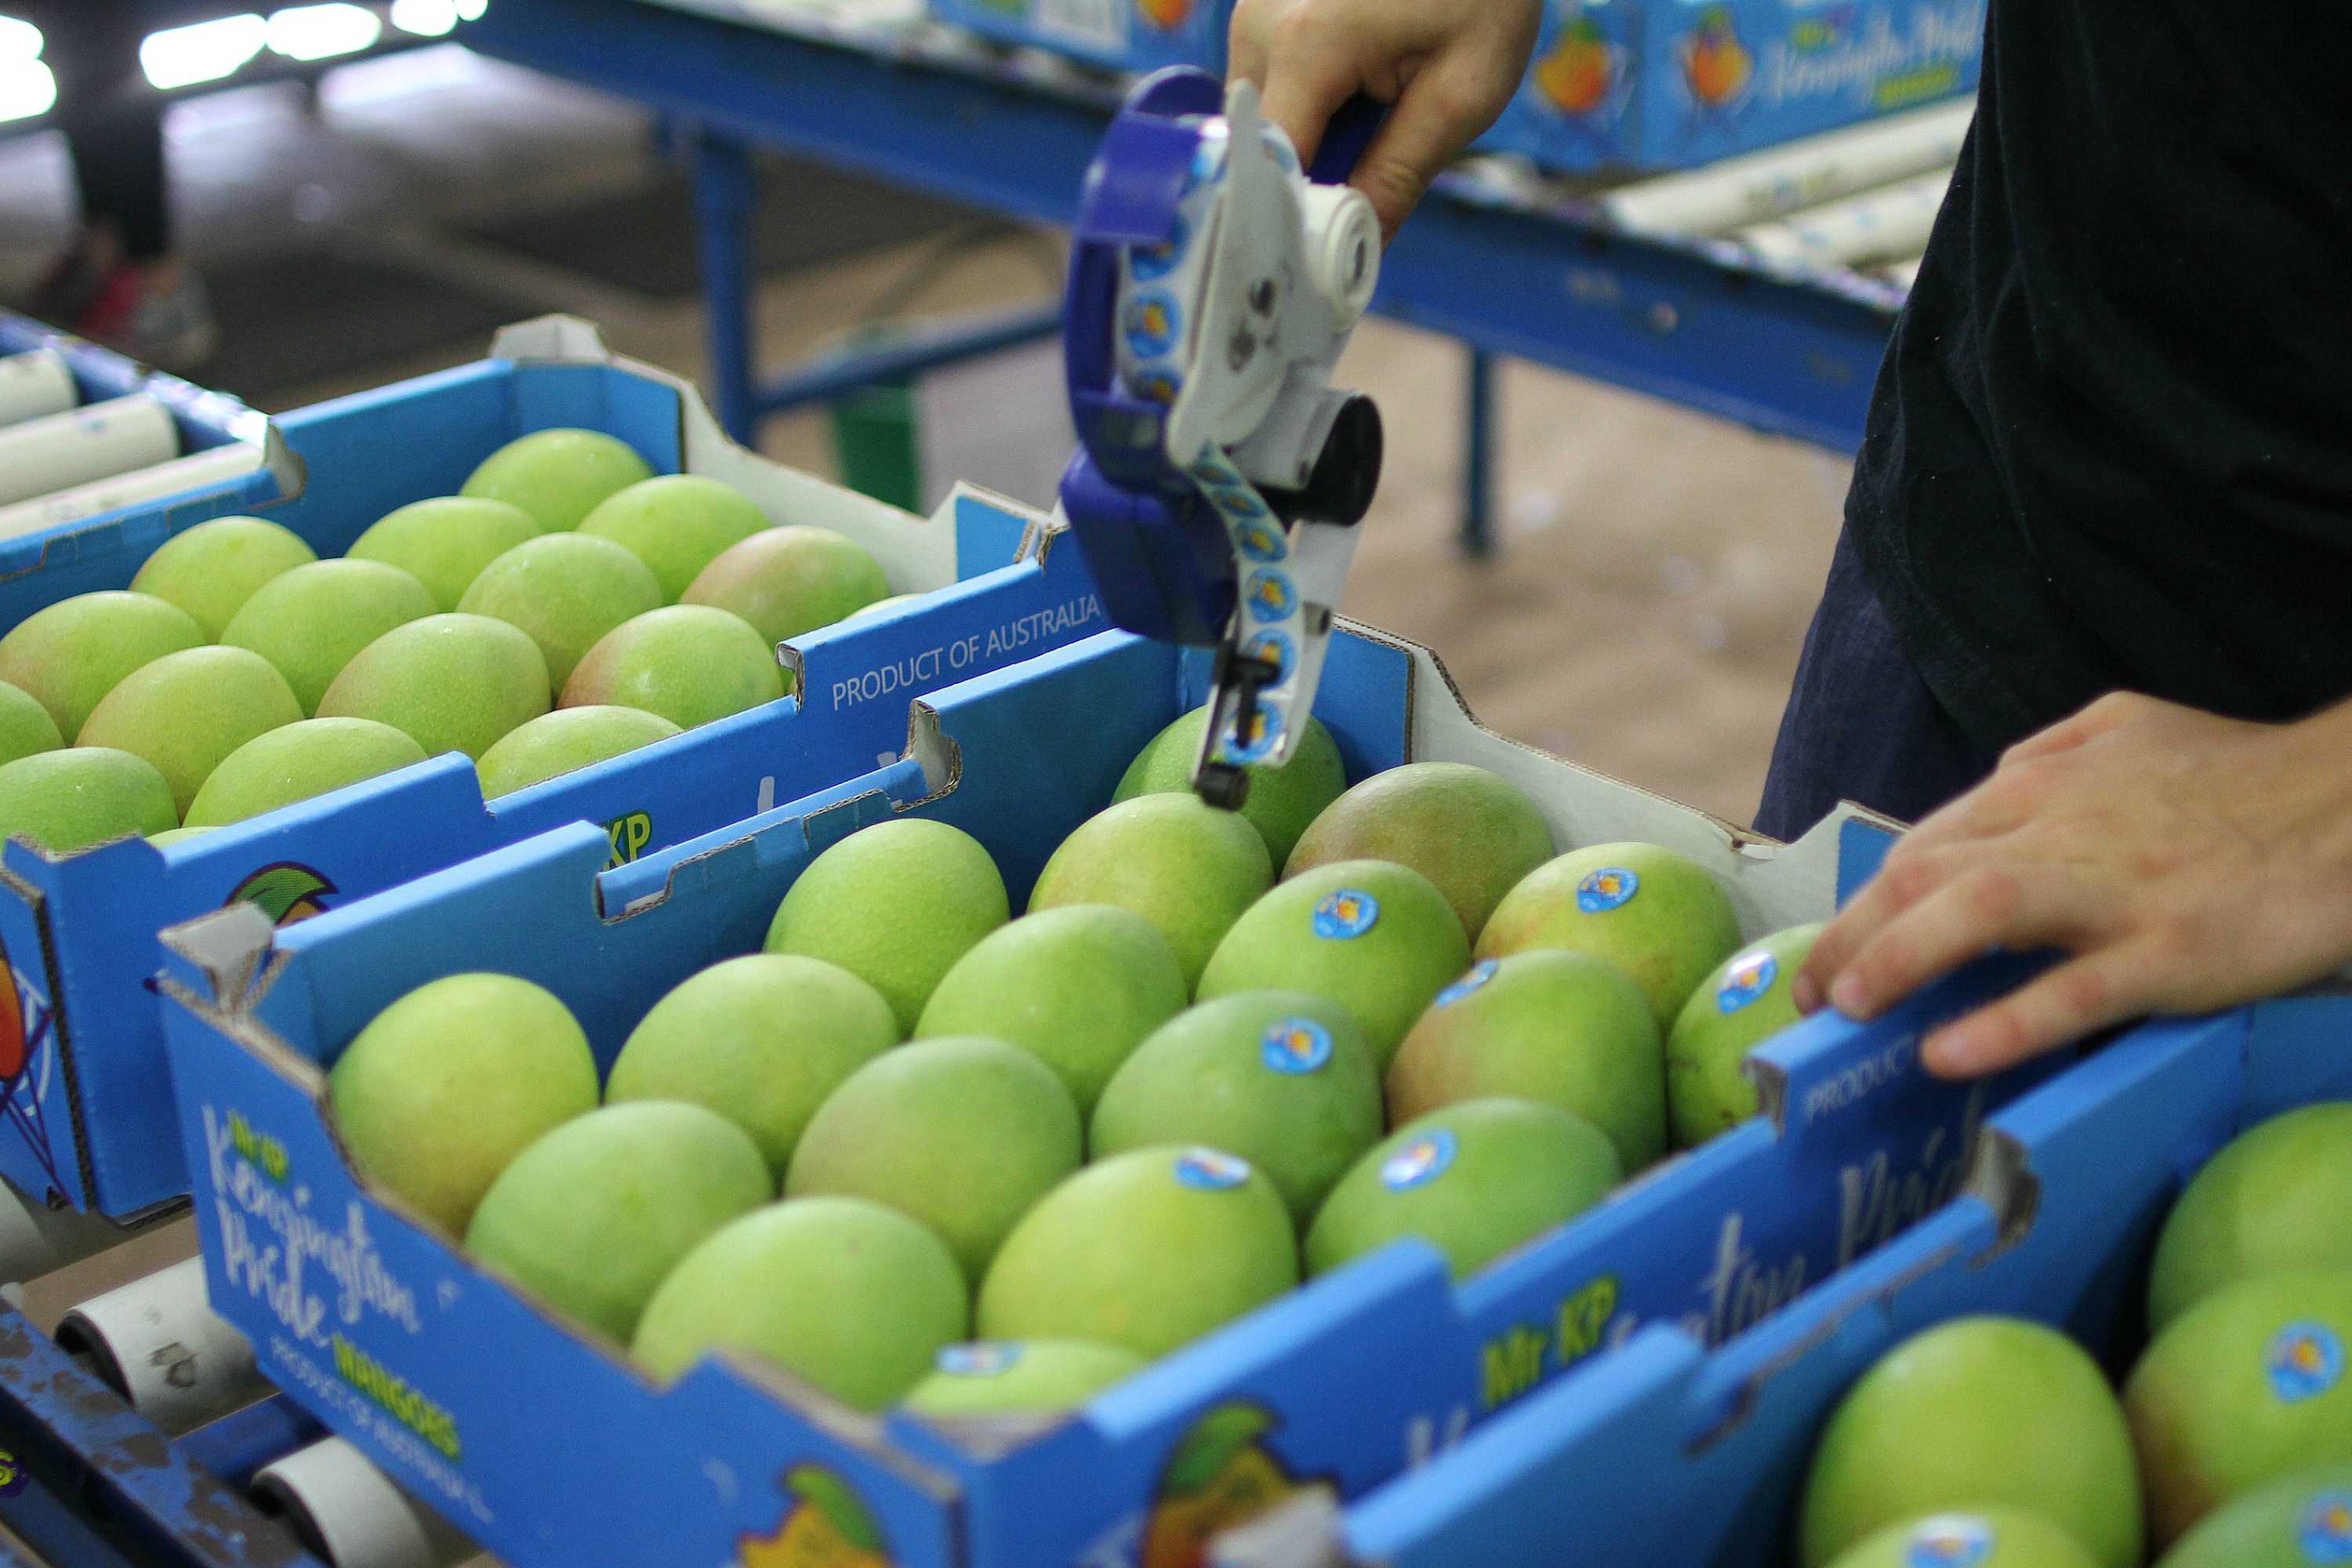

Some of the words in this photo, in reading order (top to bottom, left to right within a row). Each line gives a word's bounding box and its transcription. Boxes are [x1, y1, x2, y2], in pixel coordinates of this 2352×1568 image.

[832, 647, 944, 711] PRODUCT
[949, 633, 981, 669] OF
[985, 593, 1101, 657] AUSTRALIA
[1479, 1321, 1548, 1408] Mr
[1556, 1270, 1618, 1363] KP
